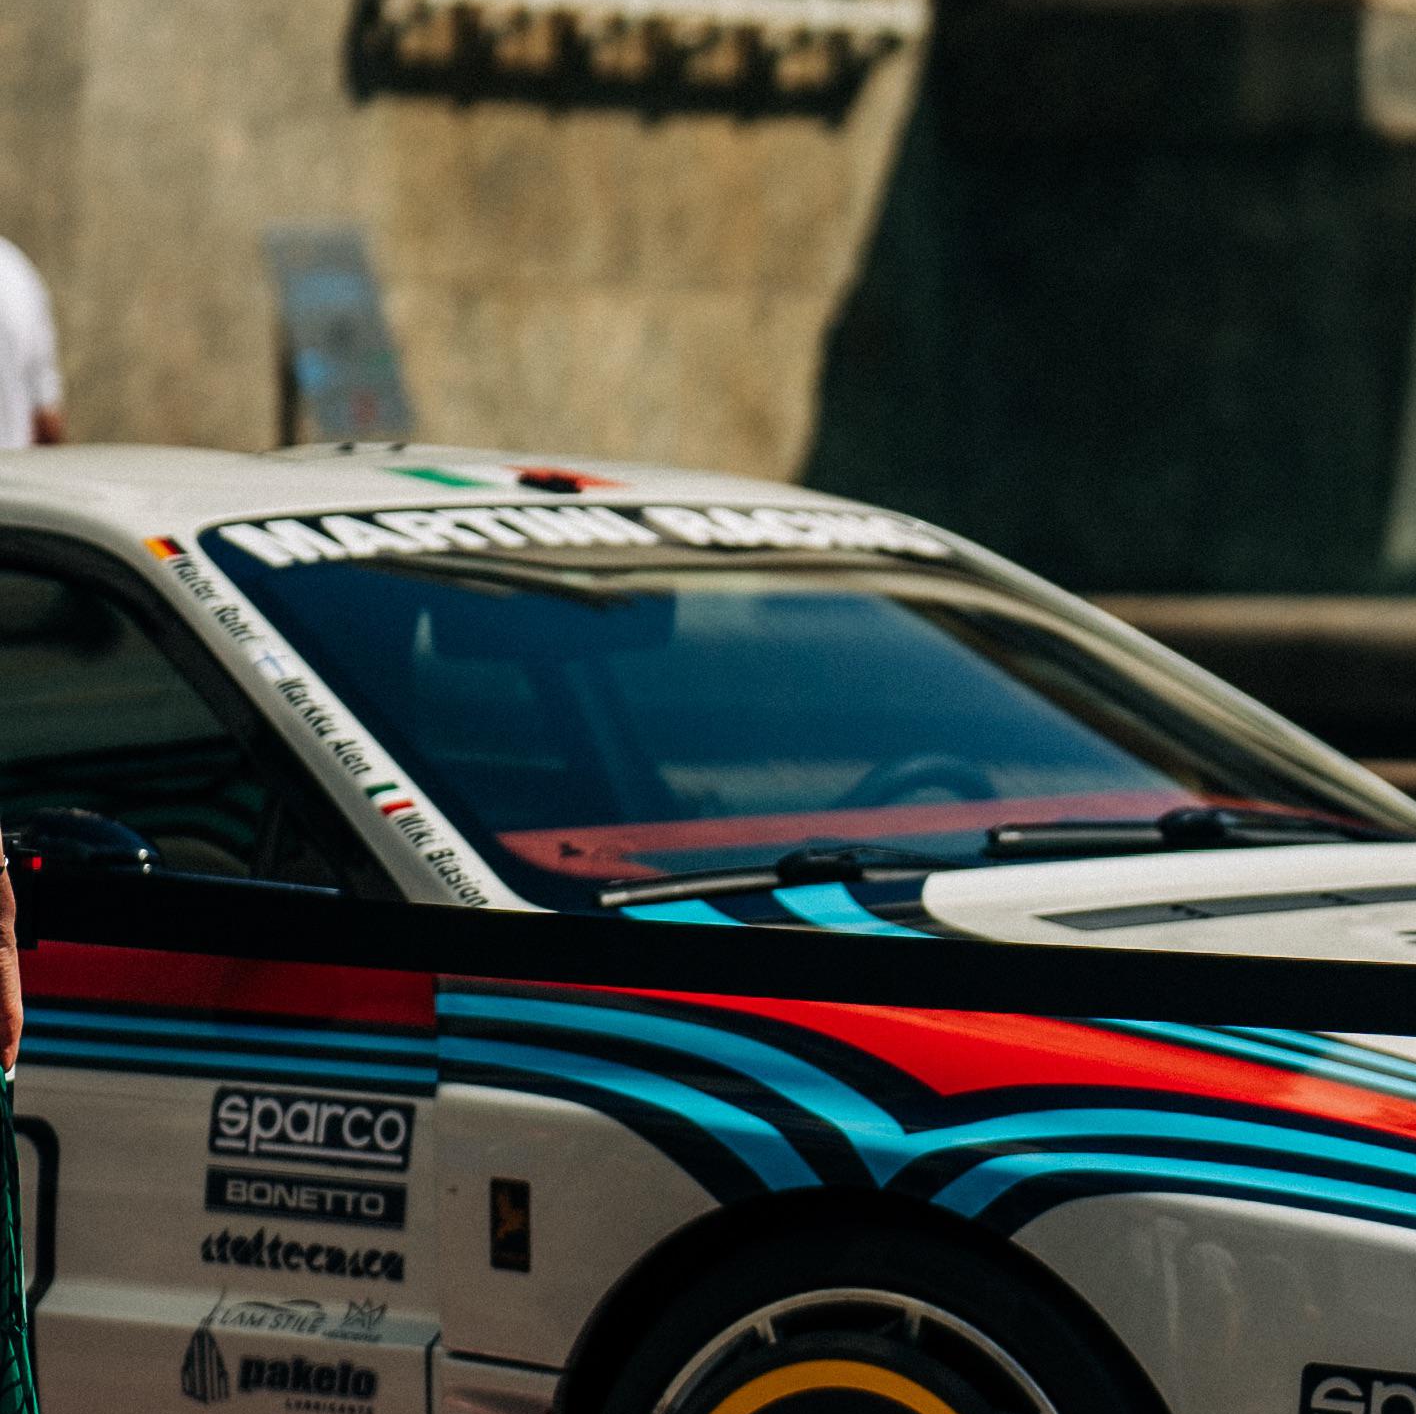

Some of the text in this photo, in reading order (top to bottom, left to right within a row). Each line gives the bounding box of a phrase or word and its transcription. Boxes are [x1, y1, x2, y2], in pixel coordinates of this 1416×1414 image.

[218, 506, 658, 568] MARTINI
[426, 848, 489, 907] Biasion
[217, 1094, 406, 1154] sparco
[225, 1179, 385, 1216] BONETTO
[239, 1354, 377, 1400] pakelo
